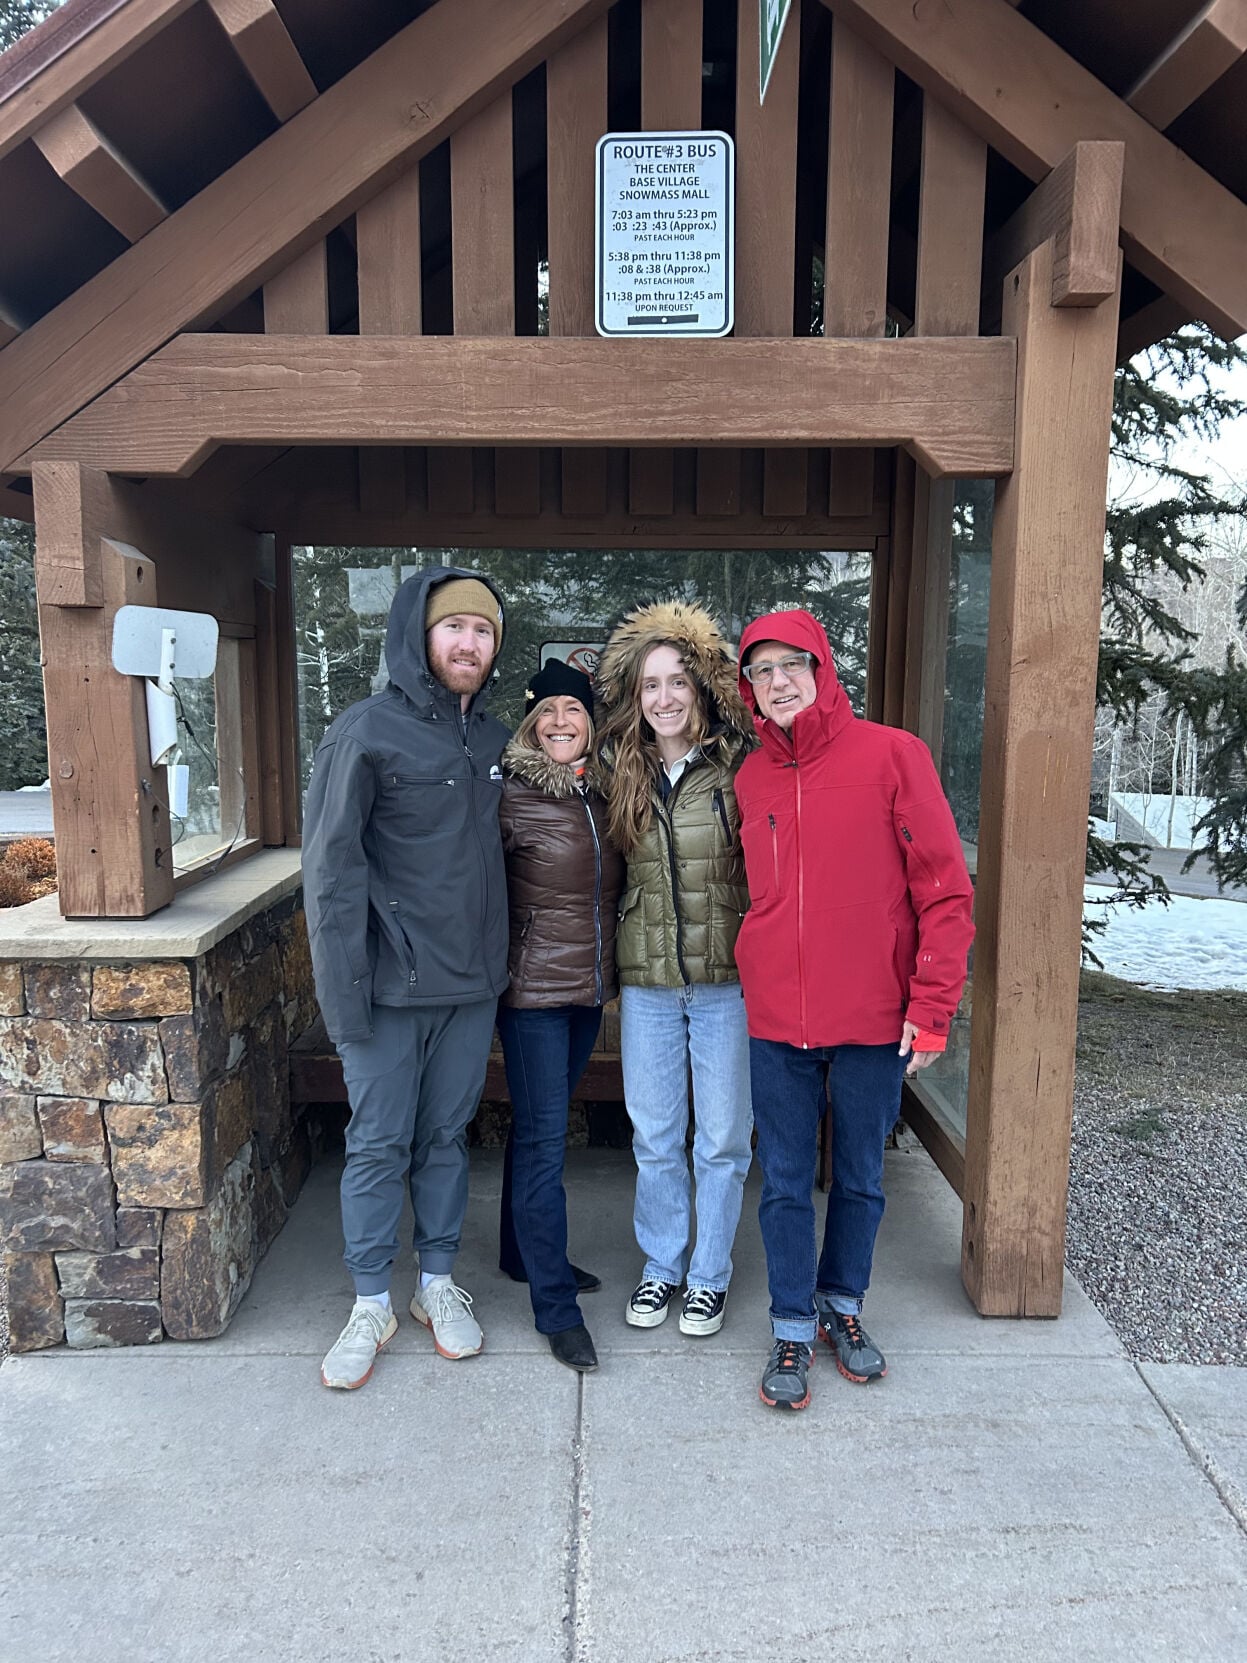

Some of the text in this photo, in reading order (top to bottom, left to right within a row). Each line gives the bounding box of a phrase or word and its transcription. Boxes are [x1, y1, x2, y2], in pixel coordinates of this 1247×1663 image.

[613, 144, 717, 159] ROUTE #3 BUS
[634, 164, 695, 174] THE CENTER
[629, 177, 700, 187] BASE VILLAGE
[619, 189, 710, 200] SNOWMASS MALL
[612, 210, 633, 219] 7:03
[653, 210, 675, 219] thru
[677, 209, 698, 218] 5:23
[701, 211, 718, 221] pm
[612, 219, 717, 232] :03 :23 :43 (Approx.)
[608, 251, 721, 263] 5:38 pm thru 11:38 pm
[618, 264, 710, 275] :08 & :38 (Approx.)
[606, 292, 633, 301] 11:38
[635, 294, 652, 303] pm
[654, 291, 676, 300] thru
[678, 291, 705, 300] 12:45
[635, 303, 694, 312] UPON REQUEST
